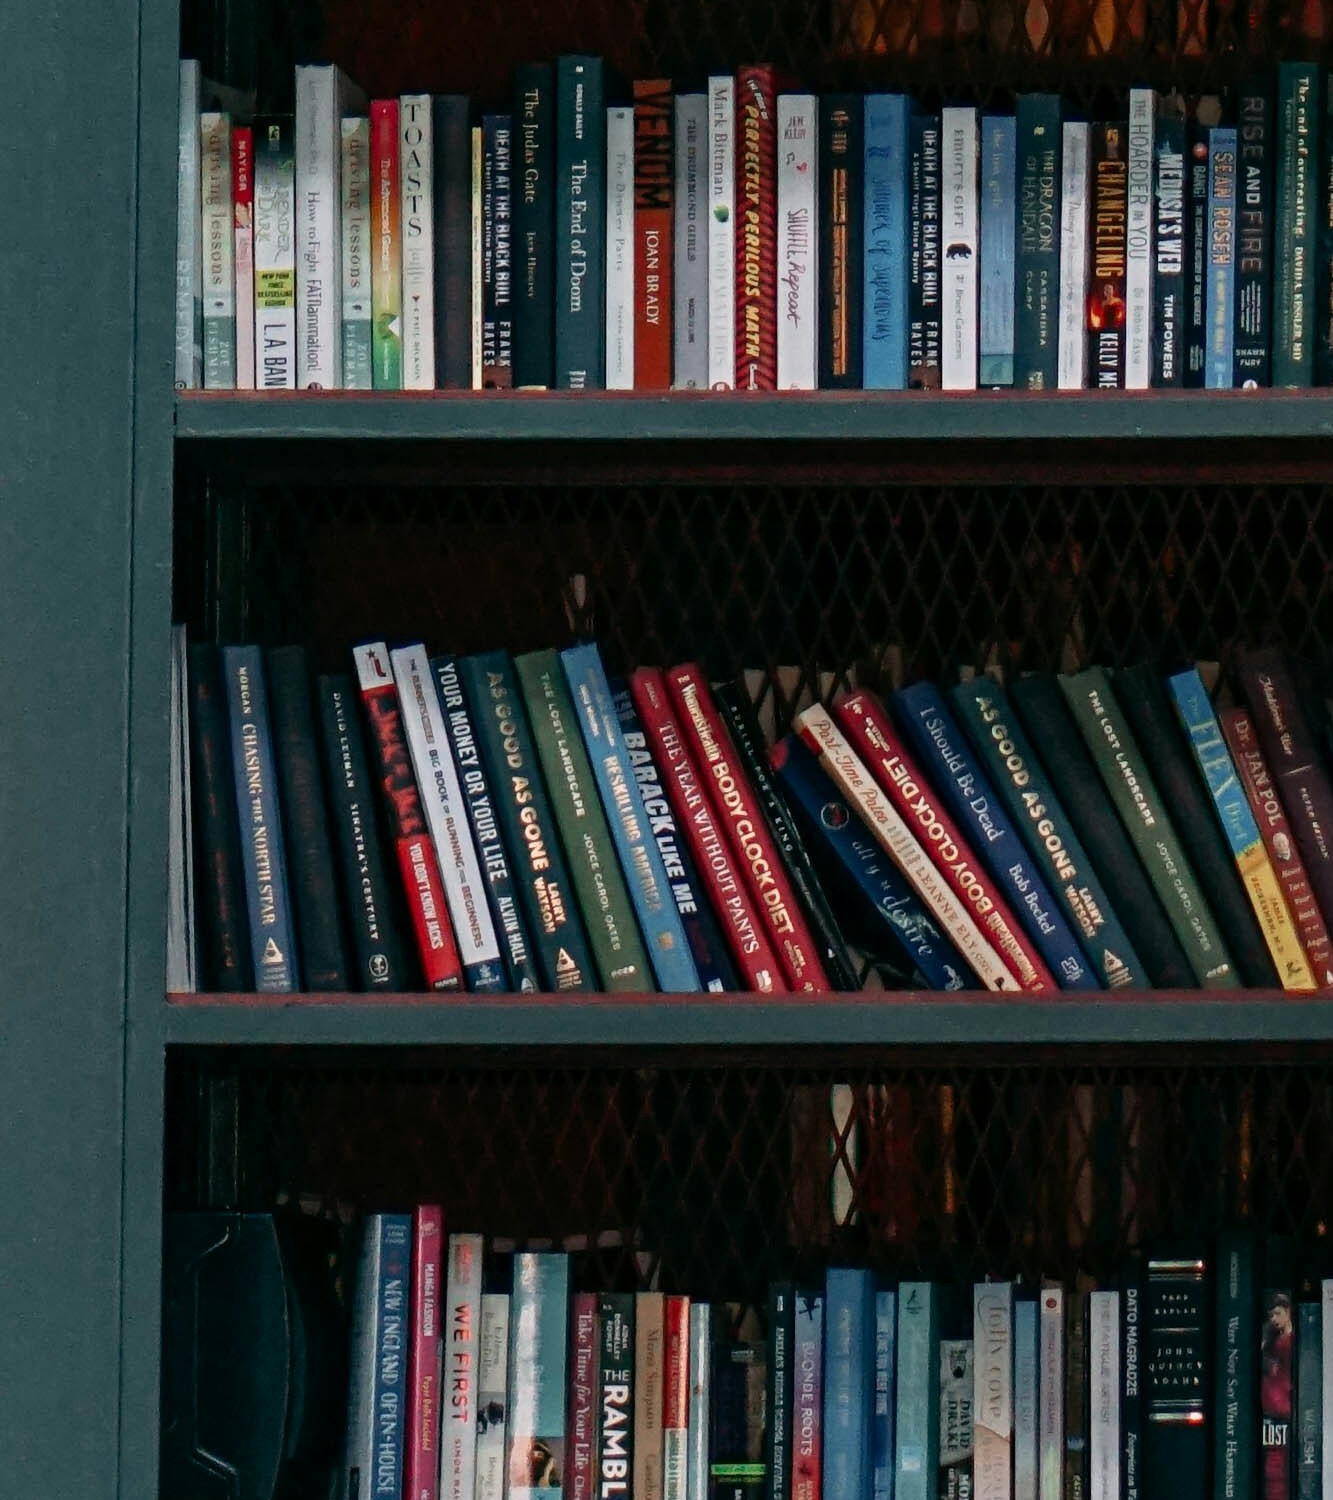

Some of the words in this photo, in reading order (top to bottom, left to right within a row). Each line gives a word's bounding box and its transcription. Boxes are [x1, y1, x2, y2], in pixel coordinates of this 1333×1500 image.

[744, 105, 759, 201] PERFECTLY
[570, 161, 587, 195] The
[570, 200, 587, 235] End
[570, 240, 587, 257] of
[645, 230, 660, 269] JOAN
[744, 211, 759, 296] PERILOUS
[570, 261, 586, 312] Doom
[645, 275, 660, 325] BRADY
[1162, 295, 1174, 321] TIM
[745, 305, 760, 357] MATH
[1162, 325, 1174, 377] POWERS
[437, 662, 458, 708] YOUR
[446, 710, 478, 766] MONEY
[462, 770, 484, 794] OR
[626, 733, 676, 833] BARACK
[467, 796, 493, 842] YOUR
[482, 844, 507, 881] LIFE
[657, 836, 685, 878] LIKE
[711, 765, 747, 818] BODY
[736, 820, 775, 888] CLOCK
[764, 888, 794, 935] DIET
[669, 884, 697, 915] ME
[383, 1280, 400, 1311] NEW
[382, 1315, 399, 1384] ENGLAND
